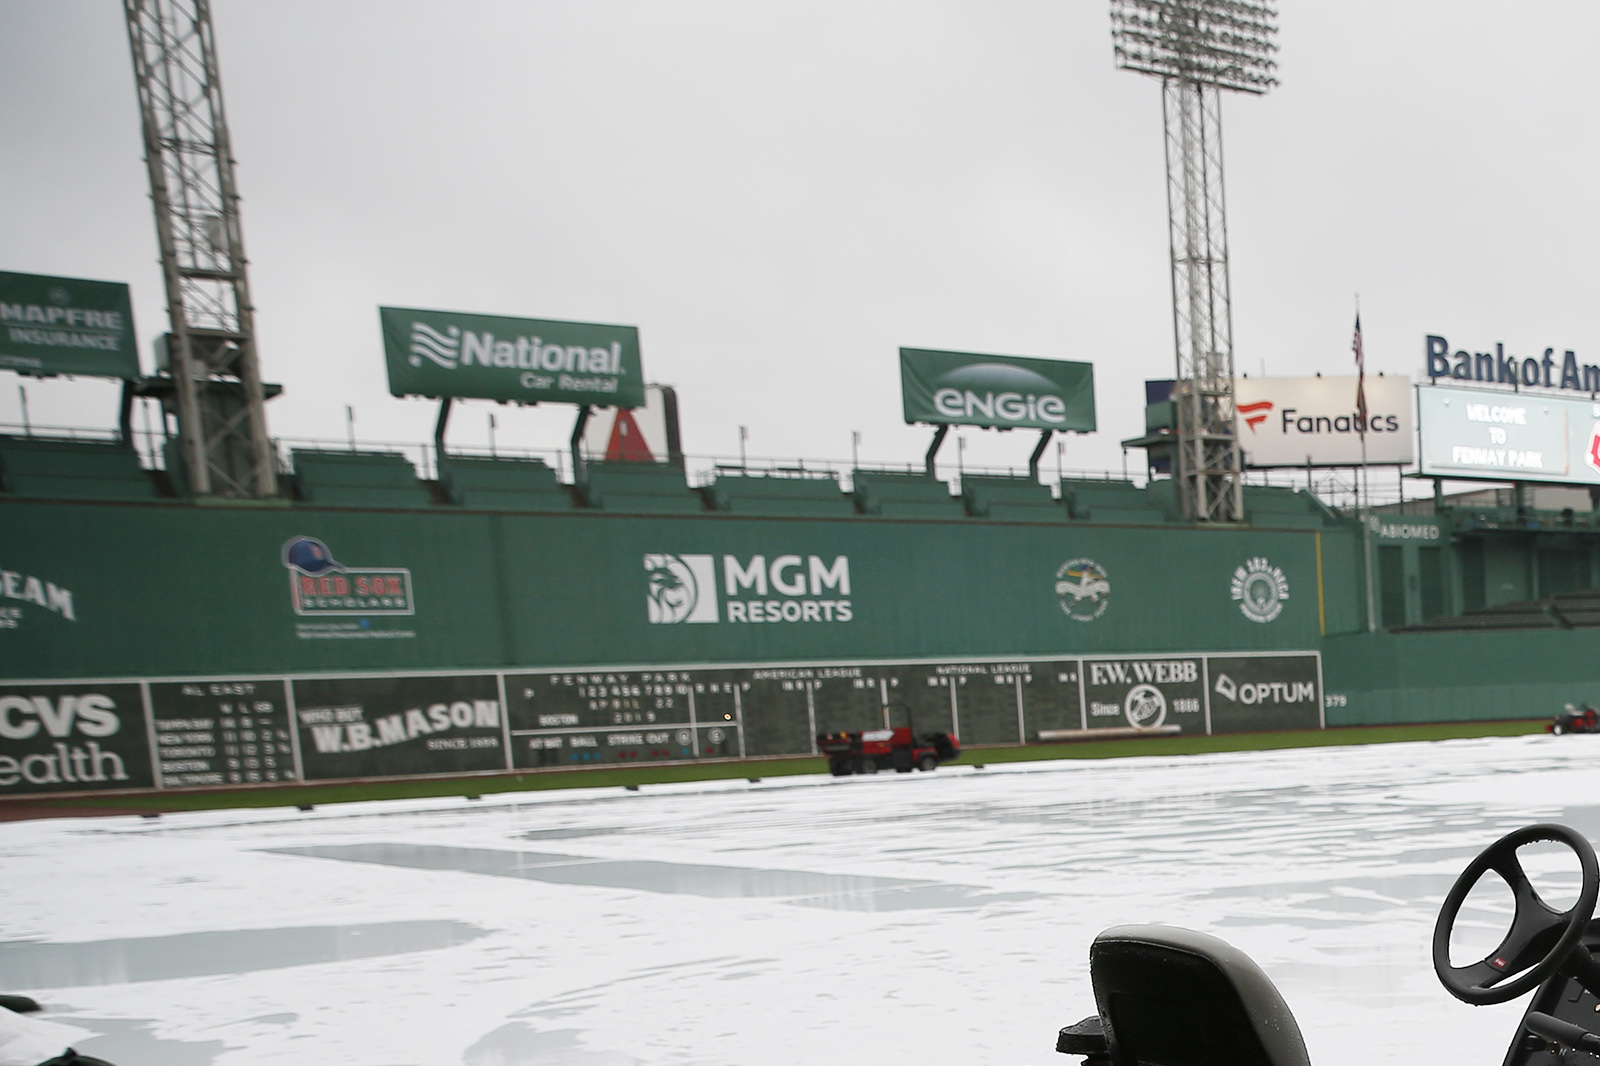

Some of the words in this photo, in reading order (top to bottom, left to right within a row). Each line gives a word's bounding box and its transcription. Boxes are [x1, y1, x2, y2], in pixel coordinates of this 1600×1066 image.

[0, 302, 123, 330] MAPFRE
[460, 330, 622, 375] National
[1426, 335, 1517, 383] Bank
[1521, 347, 1555, 389] of
[520, 372, 552, 389] Car
[557, 374, 618, 394] Rental
[1281, 408, 1399, 433] Fanatics
[1466, 404, 1526, 425] WELCOME
[1489, 427, 1507, 445] TO
[1452, 446, 1507, 466] FENWAY
[1508, 449, 1543, 468] PARK
[300, 576, 349, 596] RED
[355, 576, 403, 596] SOX
[723, 554, 851, 597] MGM
[0, 569, 76, 621] EAM
[727, 600, 853, 624] RESORTS
[550, 673, 629, 686] FENWAY
[641, 672, 691, 683] PARK
[753, 668, 814, 680] AMERICAN
[817, 668, 862, 678] LEAGUE
[936, 665, 988, 675] NATIONAL
[990, 663, 1031, 674] LEAGUE
[1133, 660, 1198, 683] WEBB
[209, 683, 255, 695] EAST
[1239, 681, 1314, 705] OPTUM
[1091, 701, 1120, 716] Since
[1325, 695, 1347, 707] 379
[0, 693, 120, 740] CVS
[312, 700, 500, 753] W.B.MASON
[538, 713, 579, 727] BOSTON
[427, 738, 468, 750] SINCE
[569, 735, 598, 748] BALL
[607, 733, 644, 746] STRIKE
[0, 741, 129, 786] ealth
